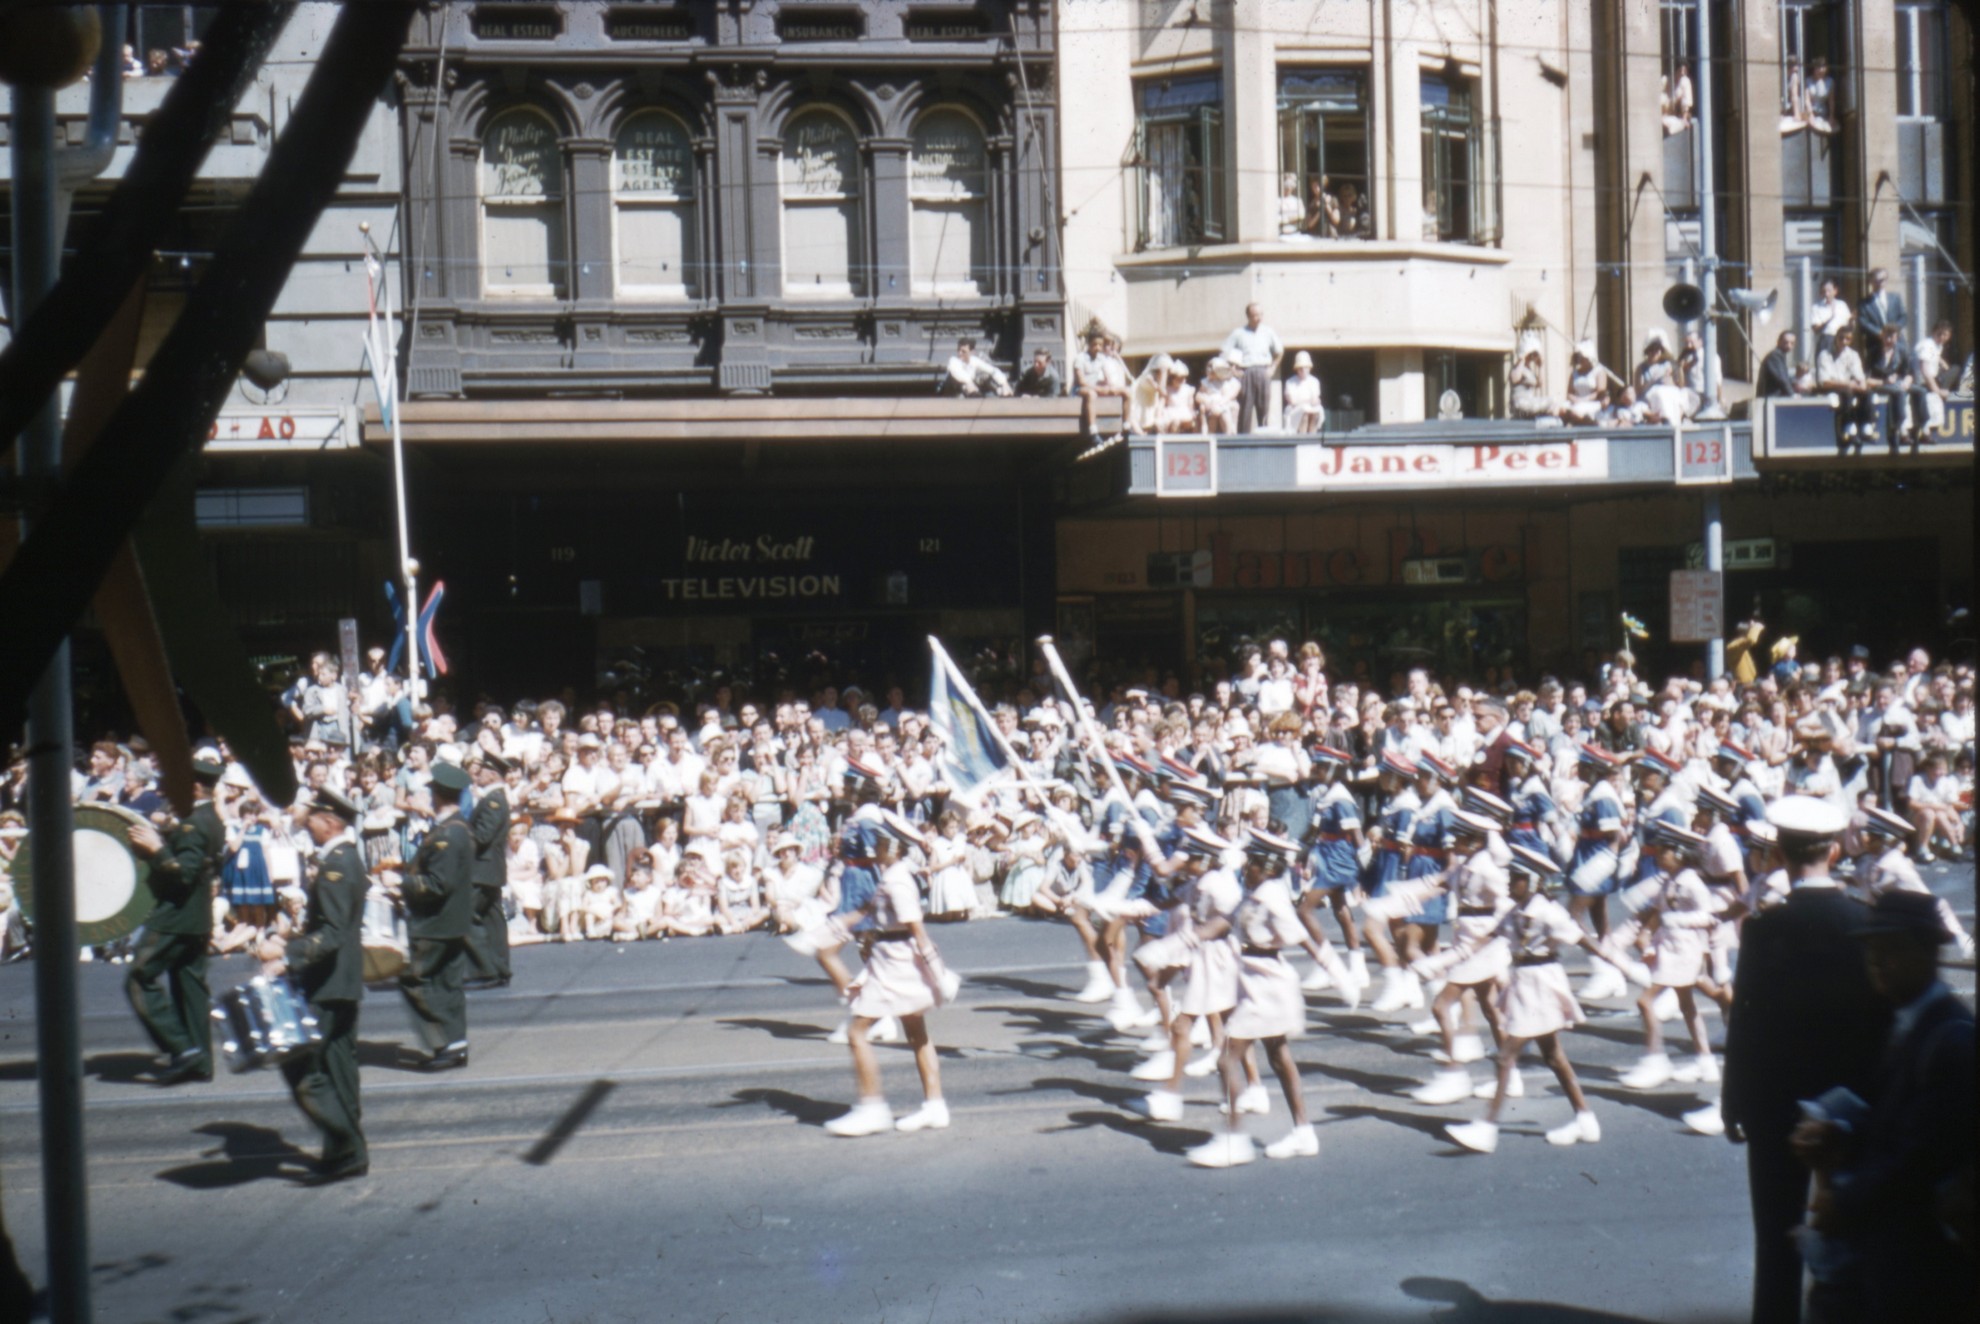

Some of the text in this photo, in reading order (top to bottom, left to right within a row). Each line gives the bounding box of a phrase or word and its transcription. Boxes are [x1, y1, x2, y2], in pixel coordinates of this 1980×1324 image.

[479, 24, 553, 37] REAL ESTATE
[612, 25, 688, 37] AUCTIONEERS
[782, 26, 855, 38] INSURANCES
[635, 131, 674, 145] REAL
[1319, 442, 1580, 476] Jane Peel
[1685, 440, 1722, 465] 123
[1167, 453, 1208, 477] 123
[551, 546, 575, 561] 119
[685, 533, 815, 563] Victor Scott
[919, 538, 940, 553] 121
[1389, 526, 1541, 585] Pel
[661, 574, 841, 600] TELEVISION
